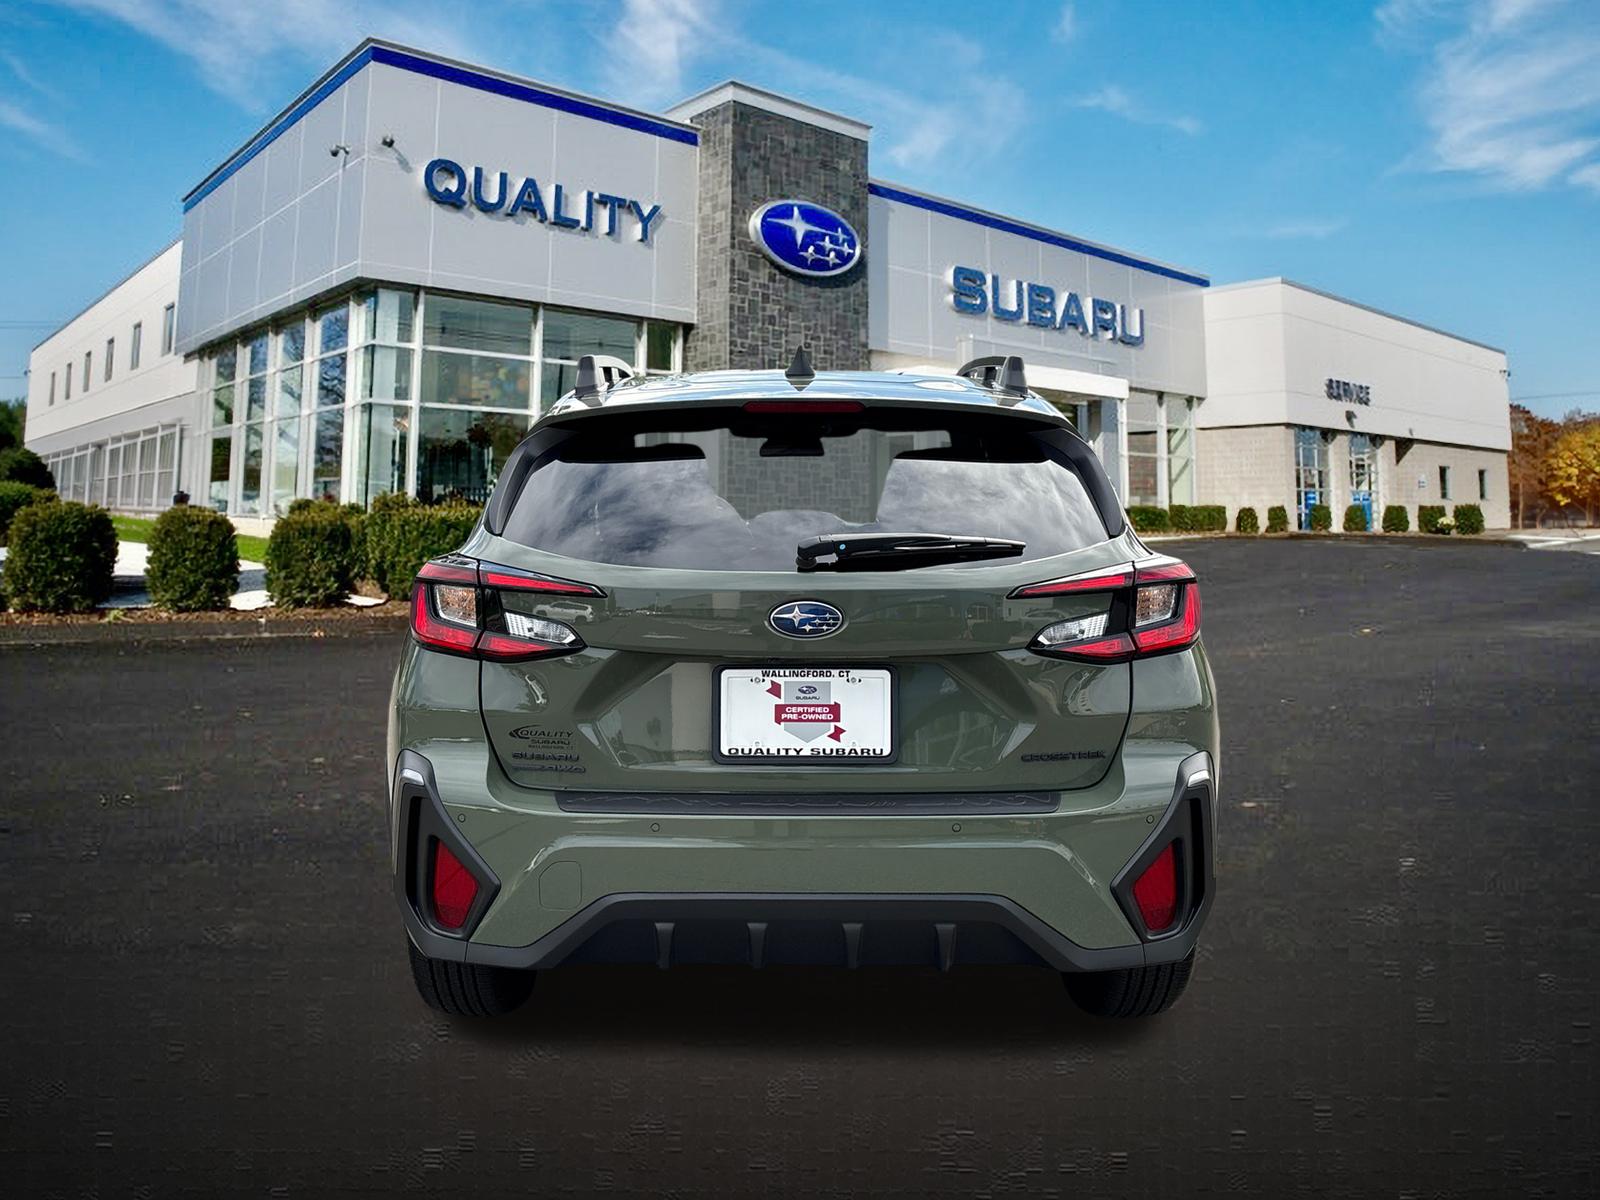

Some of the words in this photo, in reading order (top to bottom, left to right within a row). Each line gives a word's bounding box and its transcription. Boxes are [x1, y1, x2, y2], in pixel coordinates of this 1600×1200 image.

[424, 158, 662, 244] QUALITY
[948, 264, 1145, 347] SUBARU
[838, 670, 850, 678] CT
[519, 729, 574, 738] QUALITY
[512, 751, 580, 762] SUBARU
[728, 747, 803, 756] QUALITY
[810, 747, 884, 756] SUBARU
[1020, 750, 1106, 763] CROSSTREK
